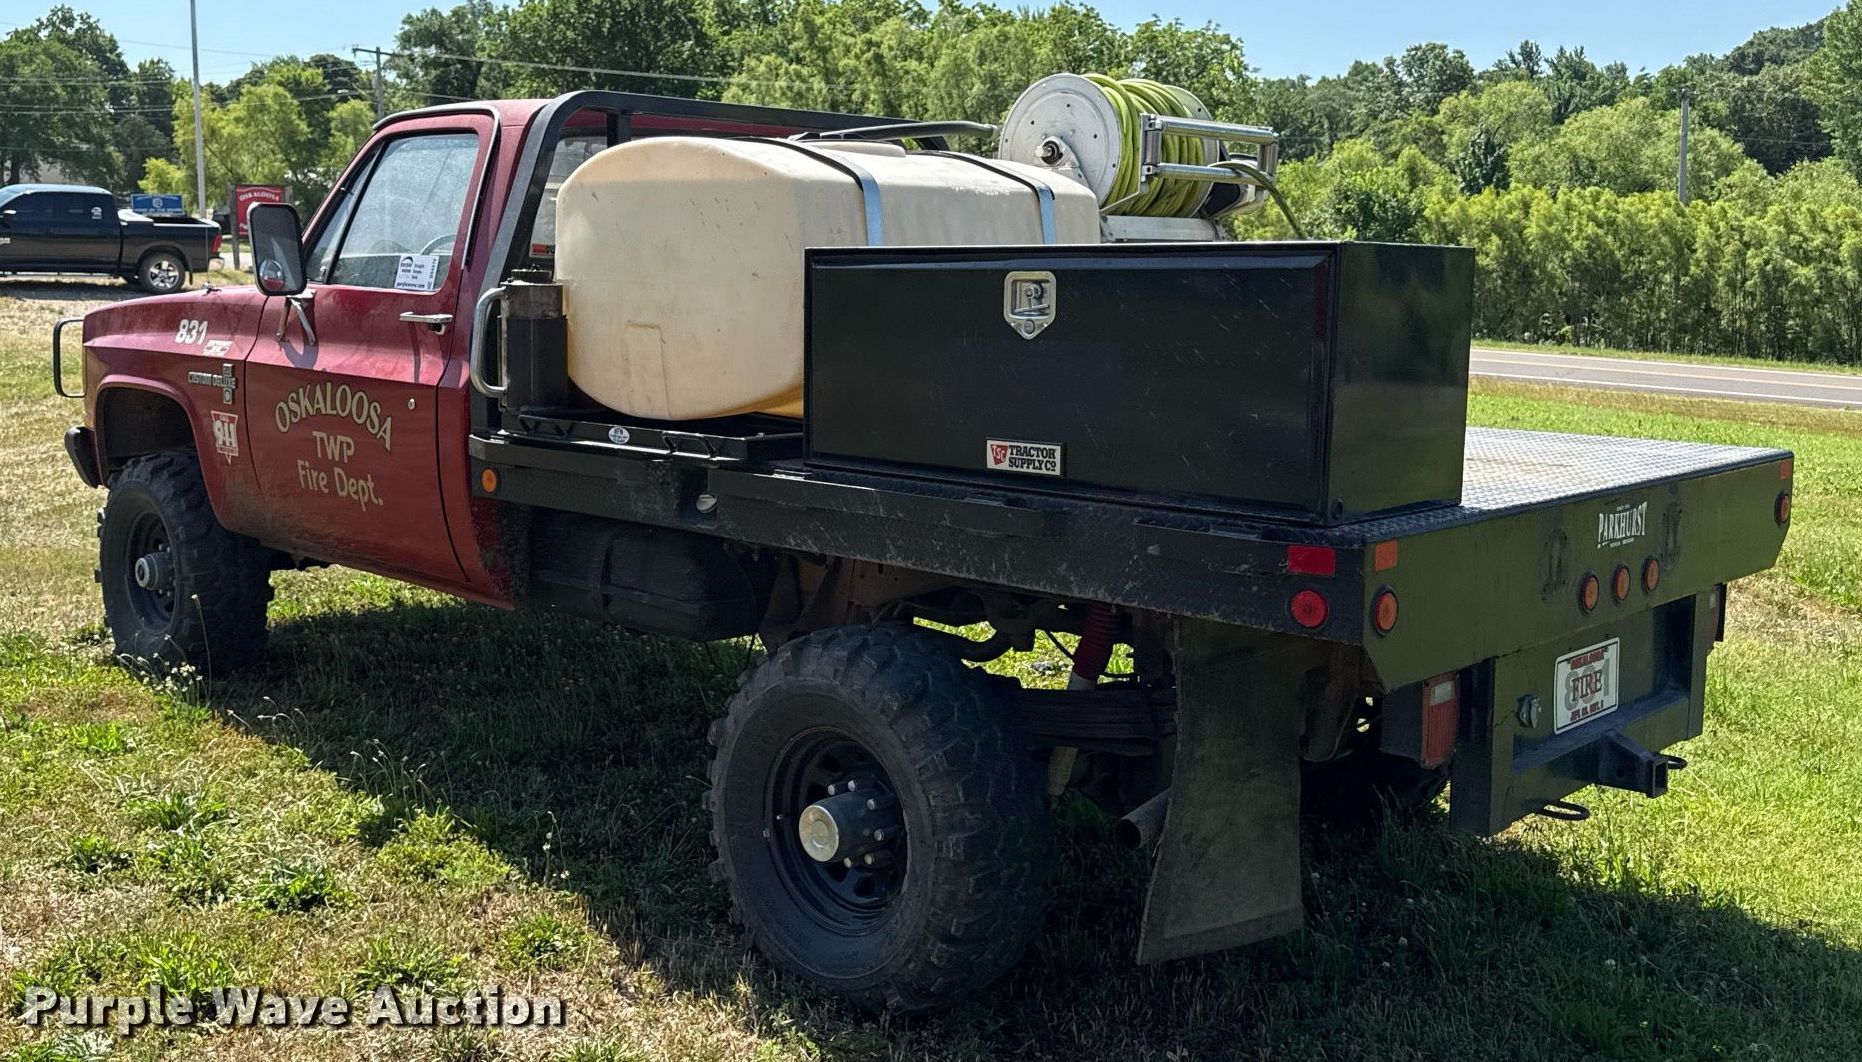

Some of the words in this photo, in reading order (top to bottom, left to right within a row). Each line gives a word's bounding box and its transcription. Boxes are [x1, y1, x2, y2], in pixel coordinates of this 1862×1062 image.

[239, 191, 280, 201] OSKALOOSA
[174, 318, 209, 346] 831
[188, 371, 212, 386] CUSTOM
[275, 381, 392, 452] OSKALOOSA
[213, 419, 237, 448] 911
[312, 430, 355, 463] TWP
[991, 445, 1007, 463] TSC
[1008, 445, 1057, 460] TRACTOR
[1008, 456, 1044, 471] SUPPLY
[297, 459, 330, 494] Fire
[333, 466, 384, 512] Dept.
[1598, 501, 1648, 543] PARKHURST
[1571, 668, 1603, 702] FIRE
